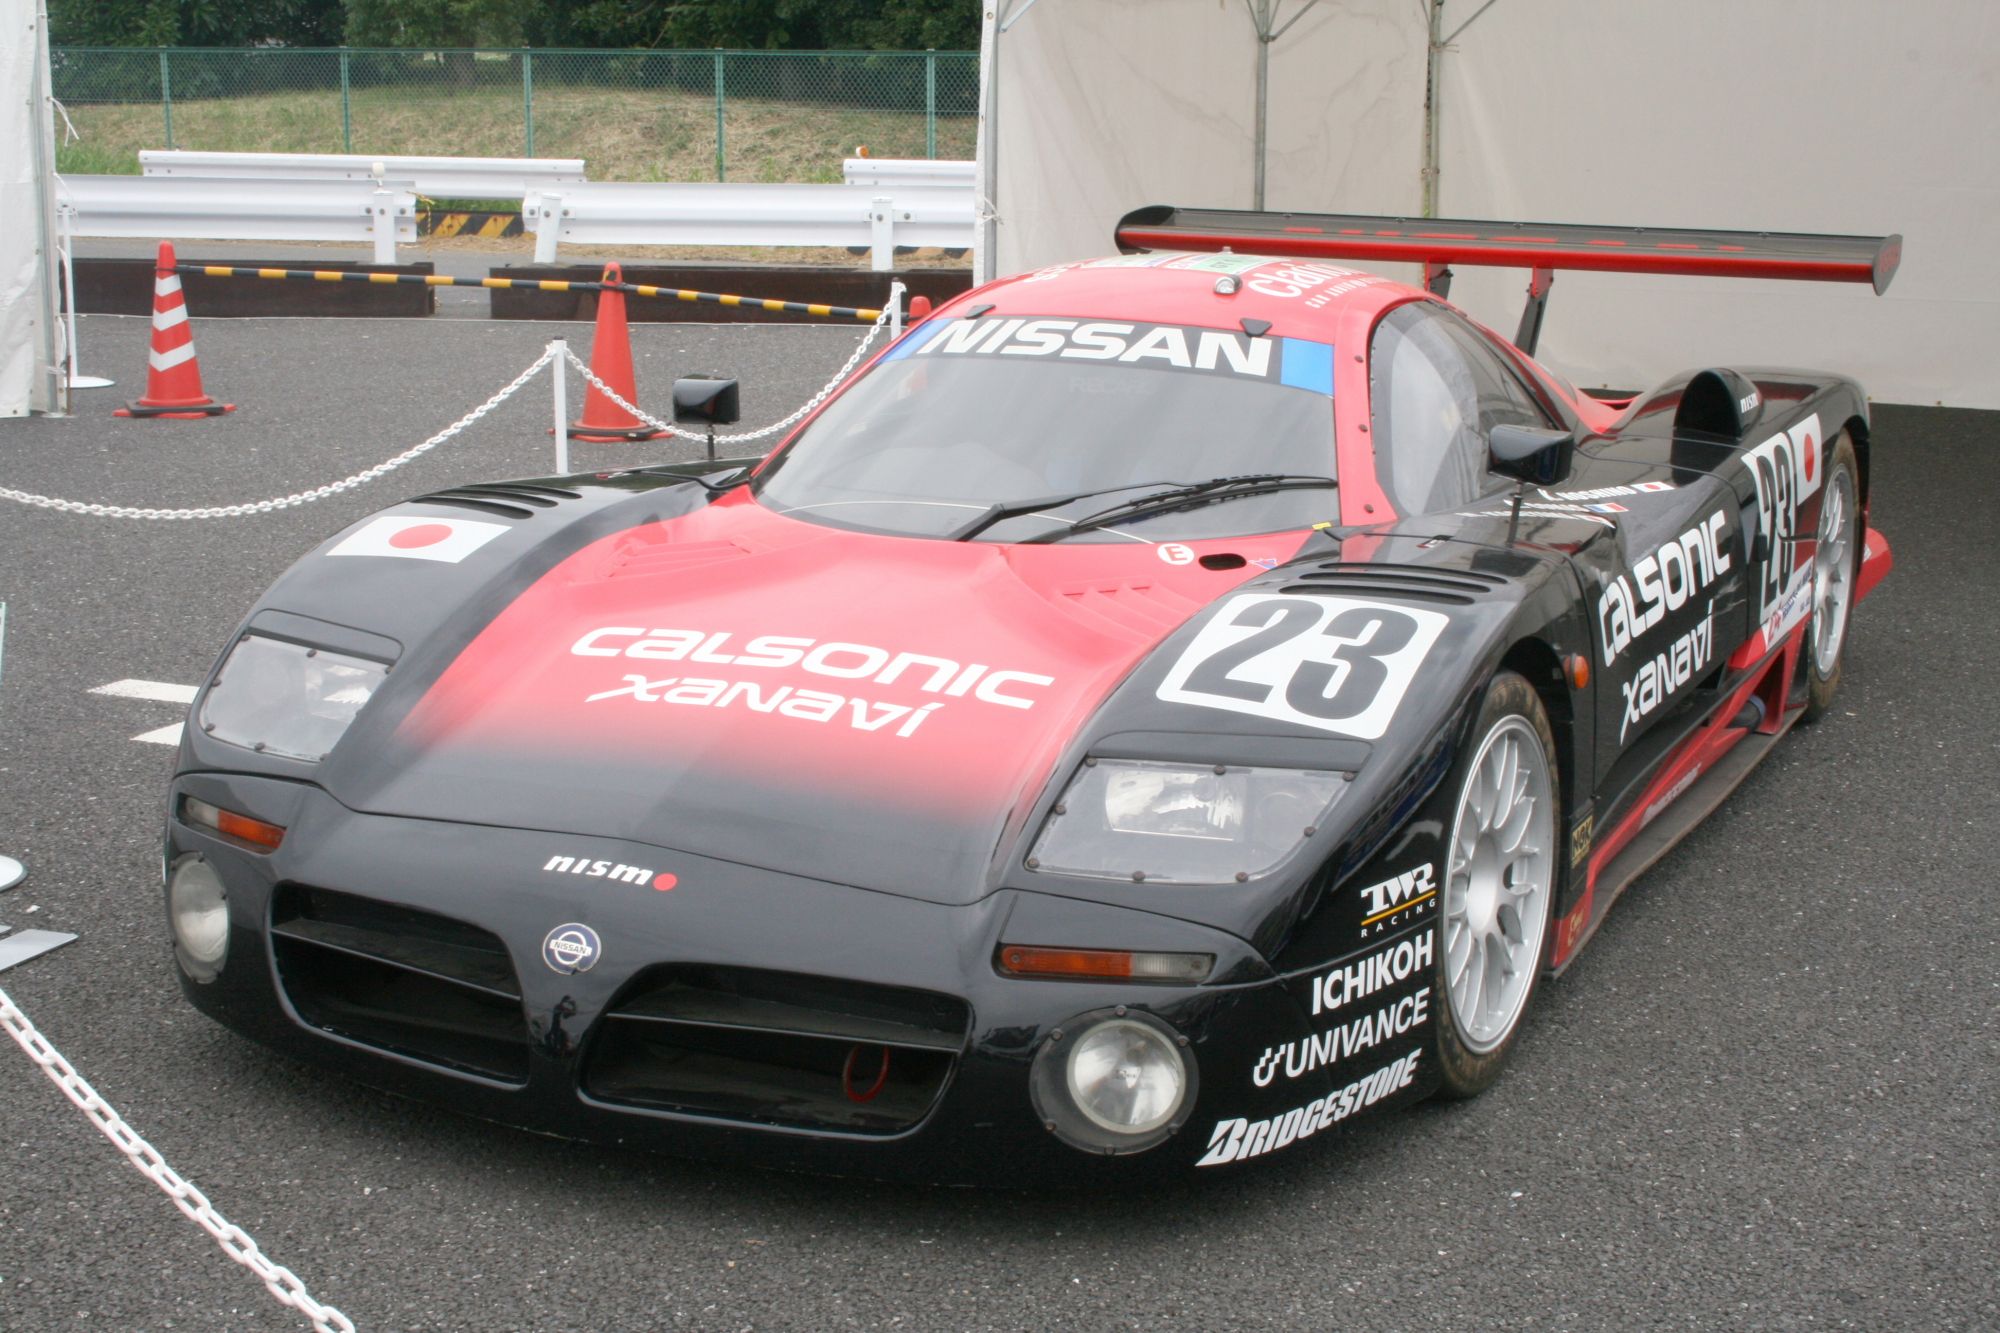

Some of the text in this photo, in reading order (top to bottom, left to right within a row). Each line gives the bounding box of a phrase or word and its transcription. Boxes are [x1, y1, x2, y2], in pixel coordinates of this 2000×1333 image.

[916, 318, 1272, 377] NISSAN
[1164, 545, 1188, 562] E
[1179, 599, 1419, 721] 23
[1360, 861, 1437, 918] TWR
[1360, 898, 1437, 939] RACING
[553, 940, 588, 955] NISSAN
[1311, 929, 1434, 1016] ICHIKOH
[1284, 987, 1431, 1078] UNIVANCE
[1194, 1047, 1422, 1168] BRIDGESTONE
